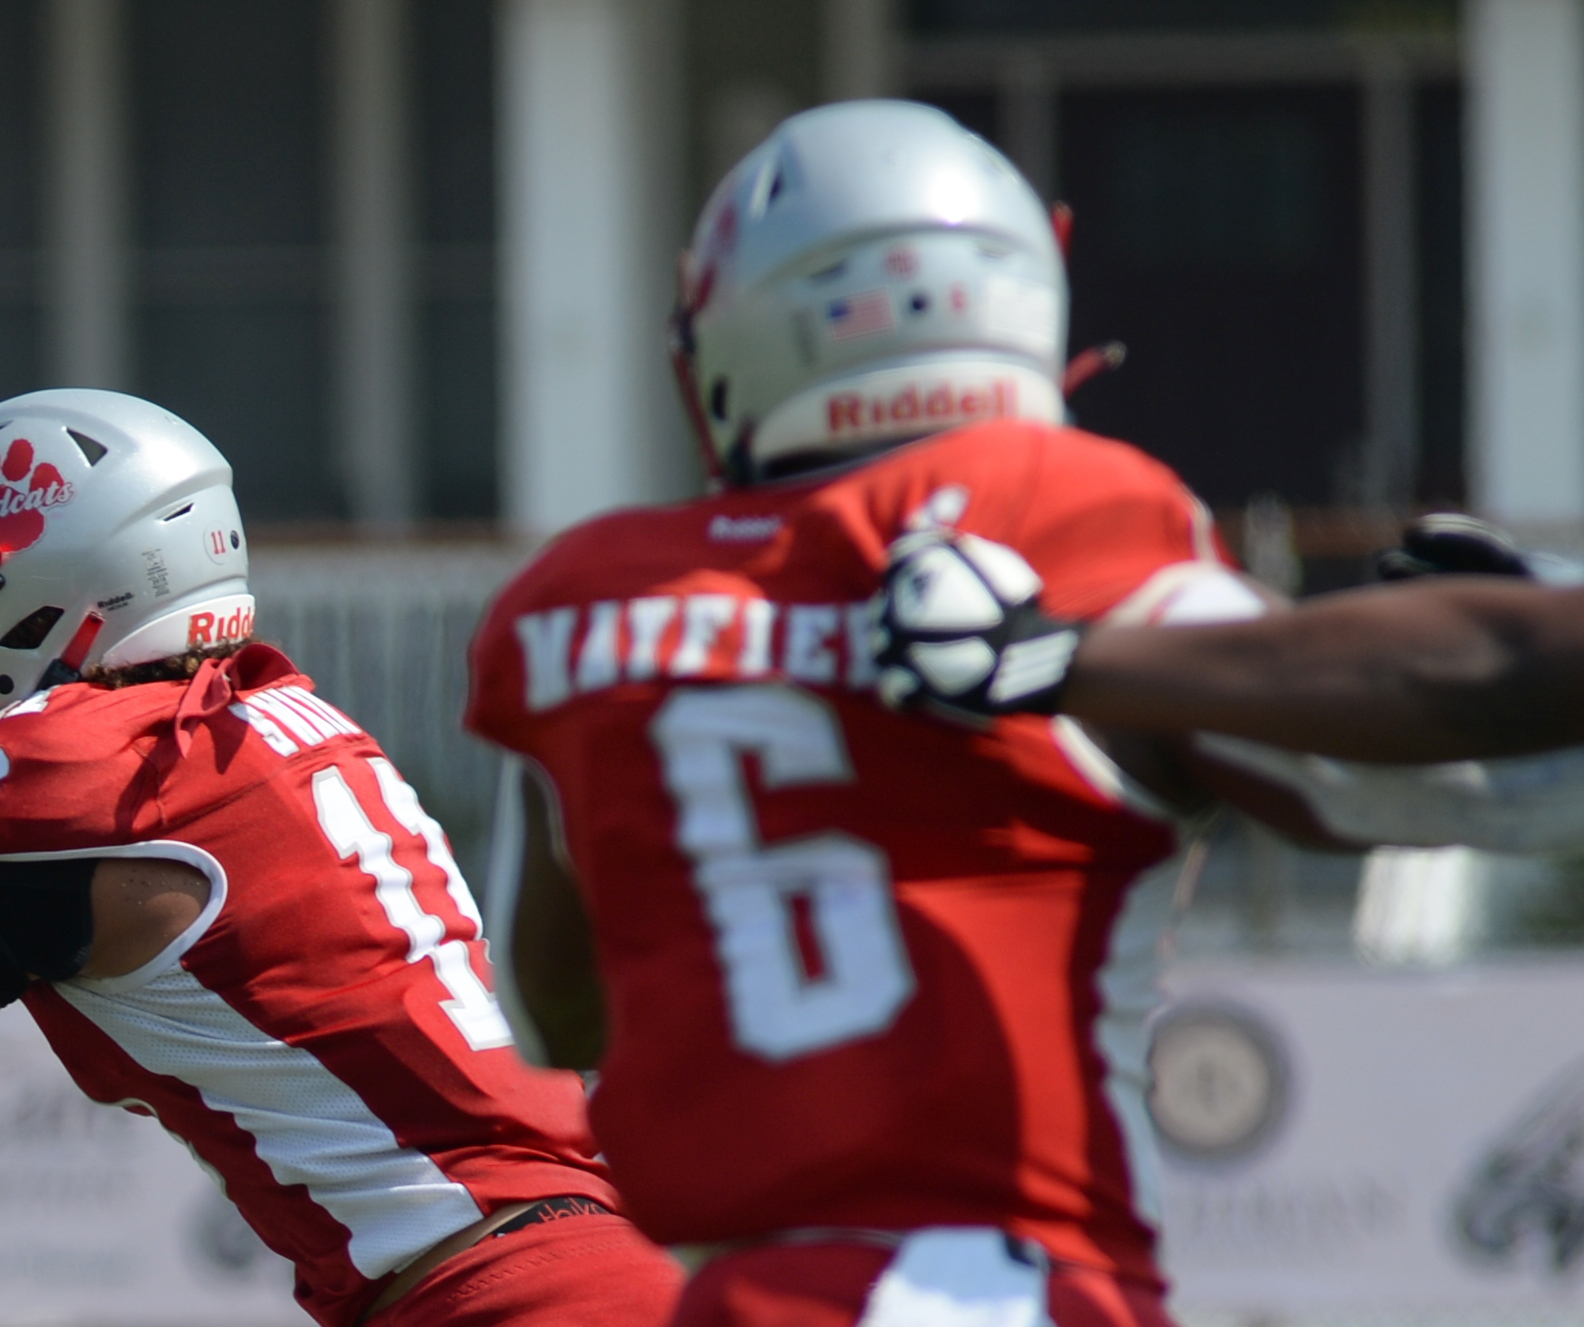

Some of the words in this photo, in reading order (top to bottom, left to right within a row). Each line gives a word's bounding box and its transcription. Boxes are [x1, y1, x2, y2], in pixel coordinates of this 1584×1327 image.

[211, 531, 226, 554] 11
[188, 607, 254, 645] Ridd
[312, 757, 513, 1051] 11
[649, 684, 918, 1063] 6
